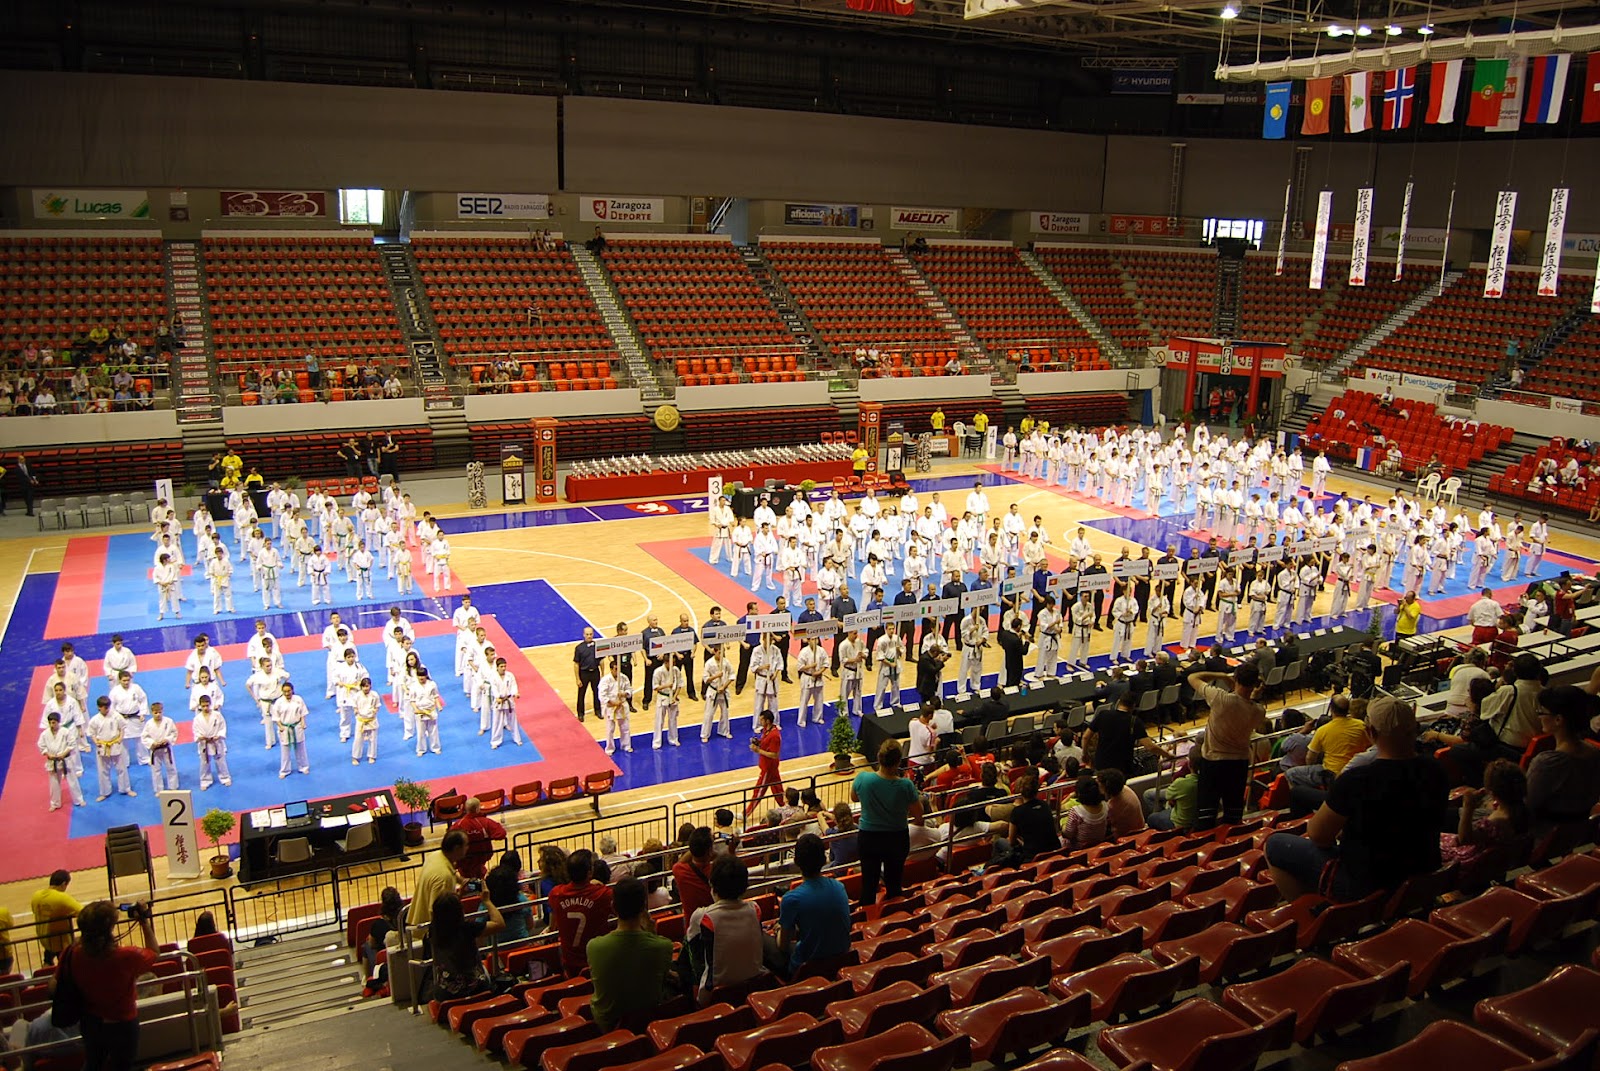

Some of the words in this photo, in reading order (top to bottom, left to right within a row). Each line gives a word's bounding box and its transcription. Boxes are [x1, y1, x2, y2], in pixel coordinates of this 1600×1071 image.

[1131, 78, 1171, 86] HYUNDAI
[74, 198, 122, 214] Lucas
[611, 200, 652, 212] Zaragoza
[611, 211, 652, 220] DEPORTE
[1052, 215, 1080, 226] Zaragoza
[1404, 376, 1426, 387] Puerto
[160, 483, 167, 497] 1
[712, 481, 720, 495] 3
[1199, 561, 1217, 569] Poland
[1088, 579, 1110, 588] Lebanon
[977, 593, 993, 602] Japan
[938, 604, 952, 613] Italy
[857, 614, 879, 624] Greece
[900, 610, 914, 618] Iran
[763, 619, 789, 629] France
[718, 630, 746, 640] Estonia
[807, 625, 837, 635] Germany
[611, 638, 643, 650] Bulgaria
[168, 799, 188, 826] 2
[560, 897, 595, 910] RONALDO
[567, 912, 586, 947] 7
